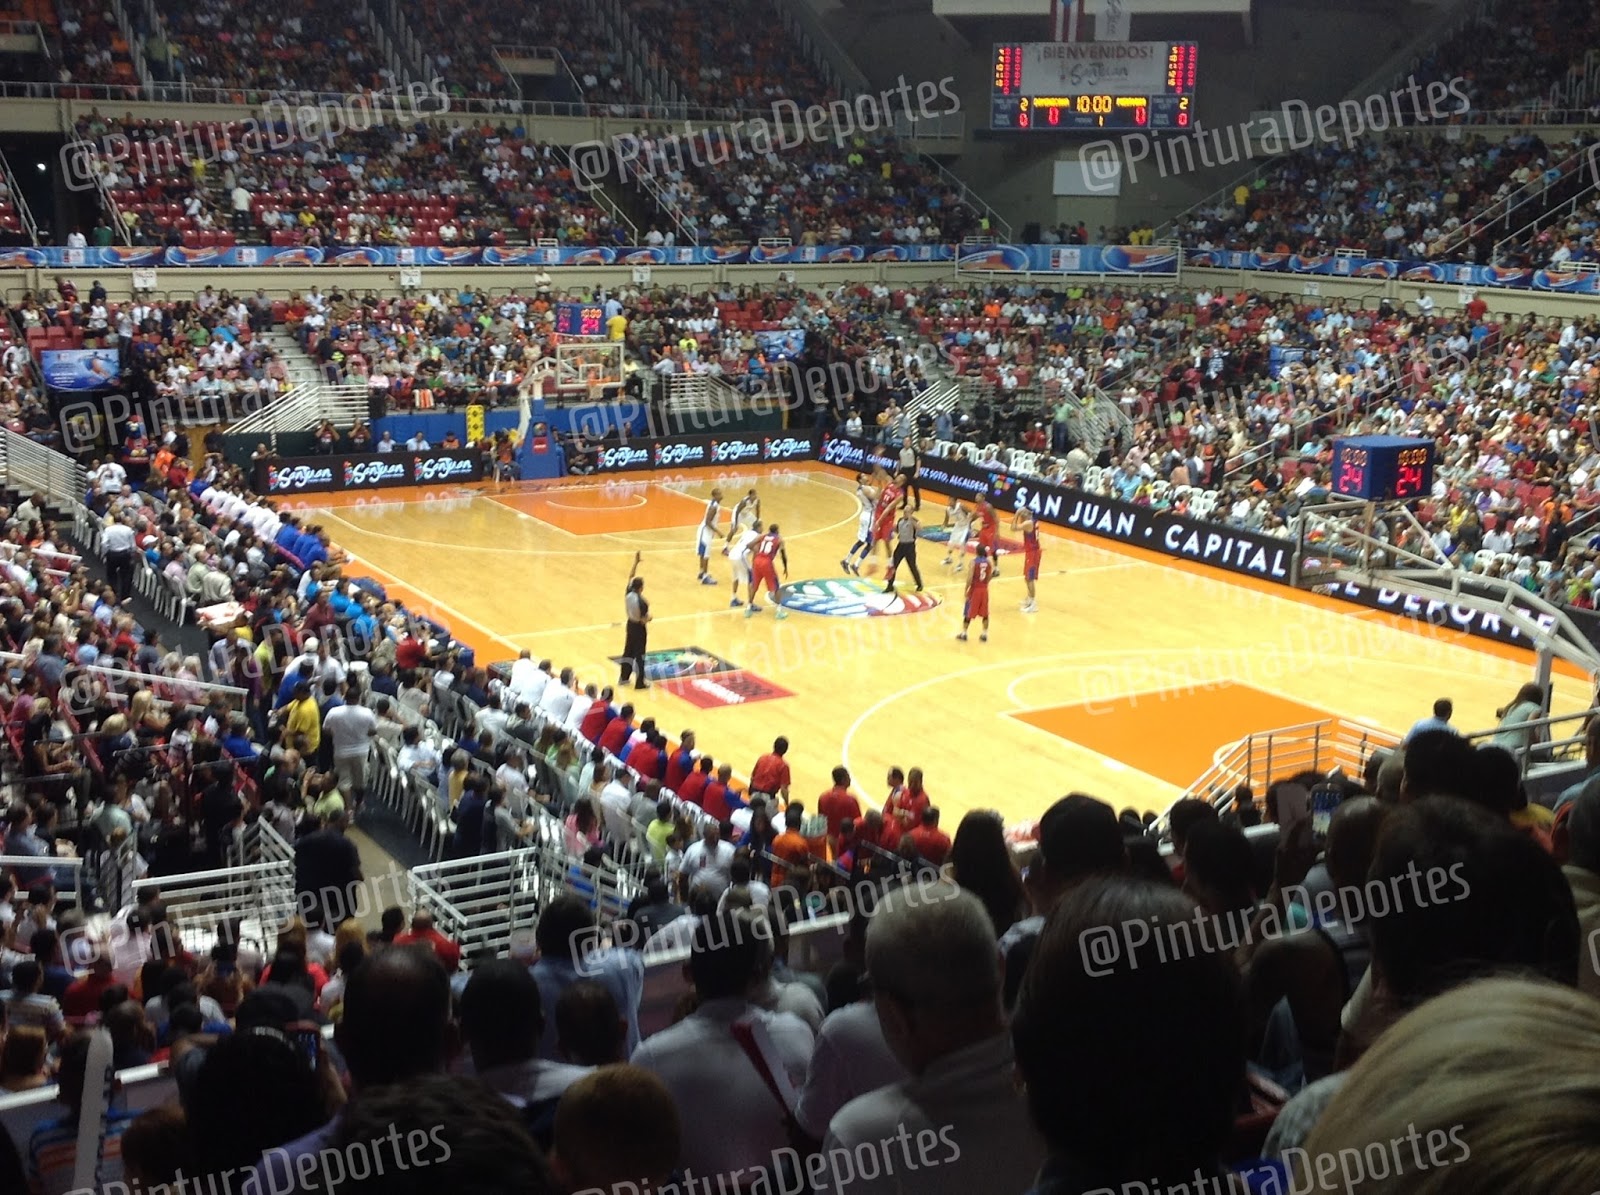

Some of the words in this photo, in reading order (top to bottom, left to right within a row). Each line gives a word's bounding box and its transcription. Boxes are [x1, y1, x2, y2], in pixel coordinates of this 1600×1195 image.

[1076, 95, 1112, 113] 10:00
[1179, 97, 1189, 110] 2
[1178, 112, 1188, 126] 0
[1339, 464, 1363, 493] 24
[1396, 466, 1422, 496] 24
[1013, 486, 1063, 518] SAN
[1068, 501, 1136, 537] JUAN
[1164, 524, 1287, 578] CAPITAL
